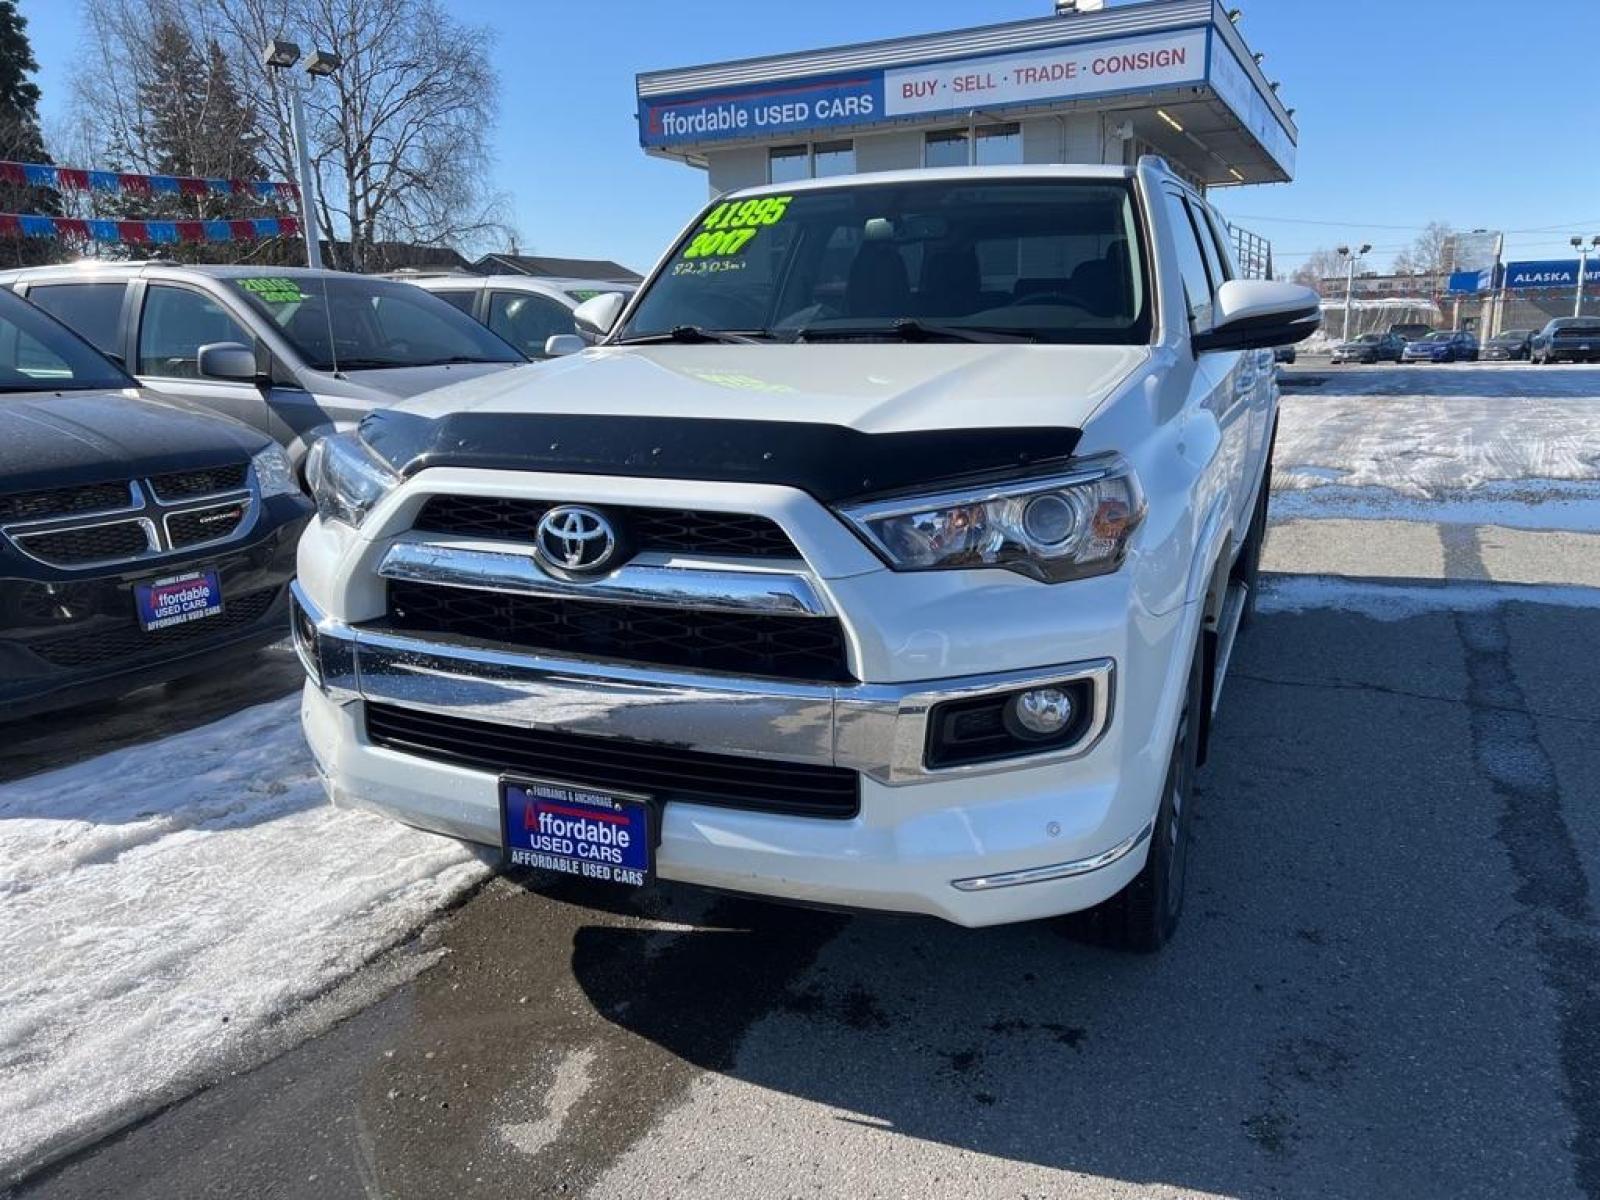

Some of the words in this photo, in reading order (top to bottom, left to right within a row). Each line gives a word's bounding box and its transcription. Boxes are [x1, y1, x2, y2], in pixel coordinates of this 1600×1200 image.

[902, 79, 938, 98] BUY
[953, 73, 996, 93] SELL
[1014, 62, 1077, 85] TRADE
[1091, 48, 1186, 76] CONSIGN
[754, 102, 810, 126] USED
[815, 94, 874, 119] CARS
[703, 197, 792, 228] 41995
[684, 228, 756, 258] 2017
[1514, 272, 1570, 282] ALASKA
[155, 605, 181, 618] USED
[182, 598, 208, 612] CARS
[524, 800, 631, 848] Affordable
[530, 834, 574, 854] USED
[577, 842, 623, 864] CARS
[511, 850, 579, 875] AFFORDABLE
[582, 863, 612, 881] USED
[613, 869, 643, 888] CARS
